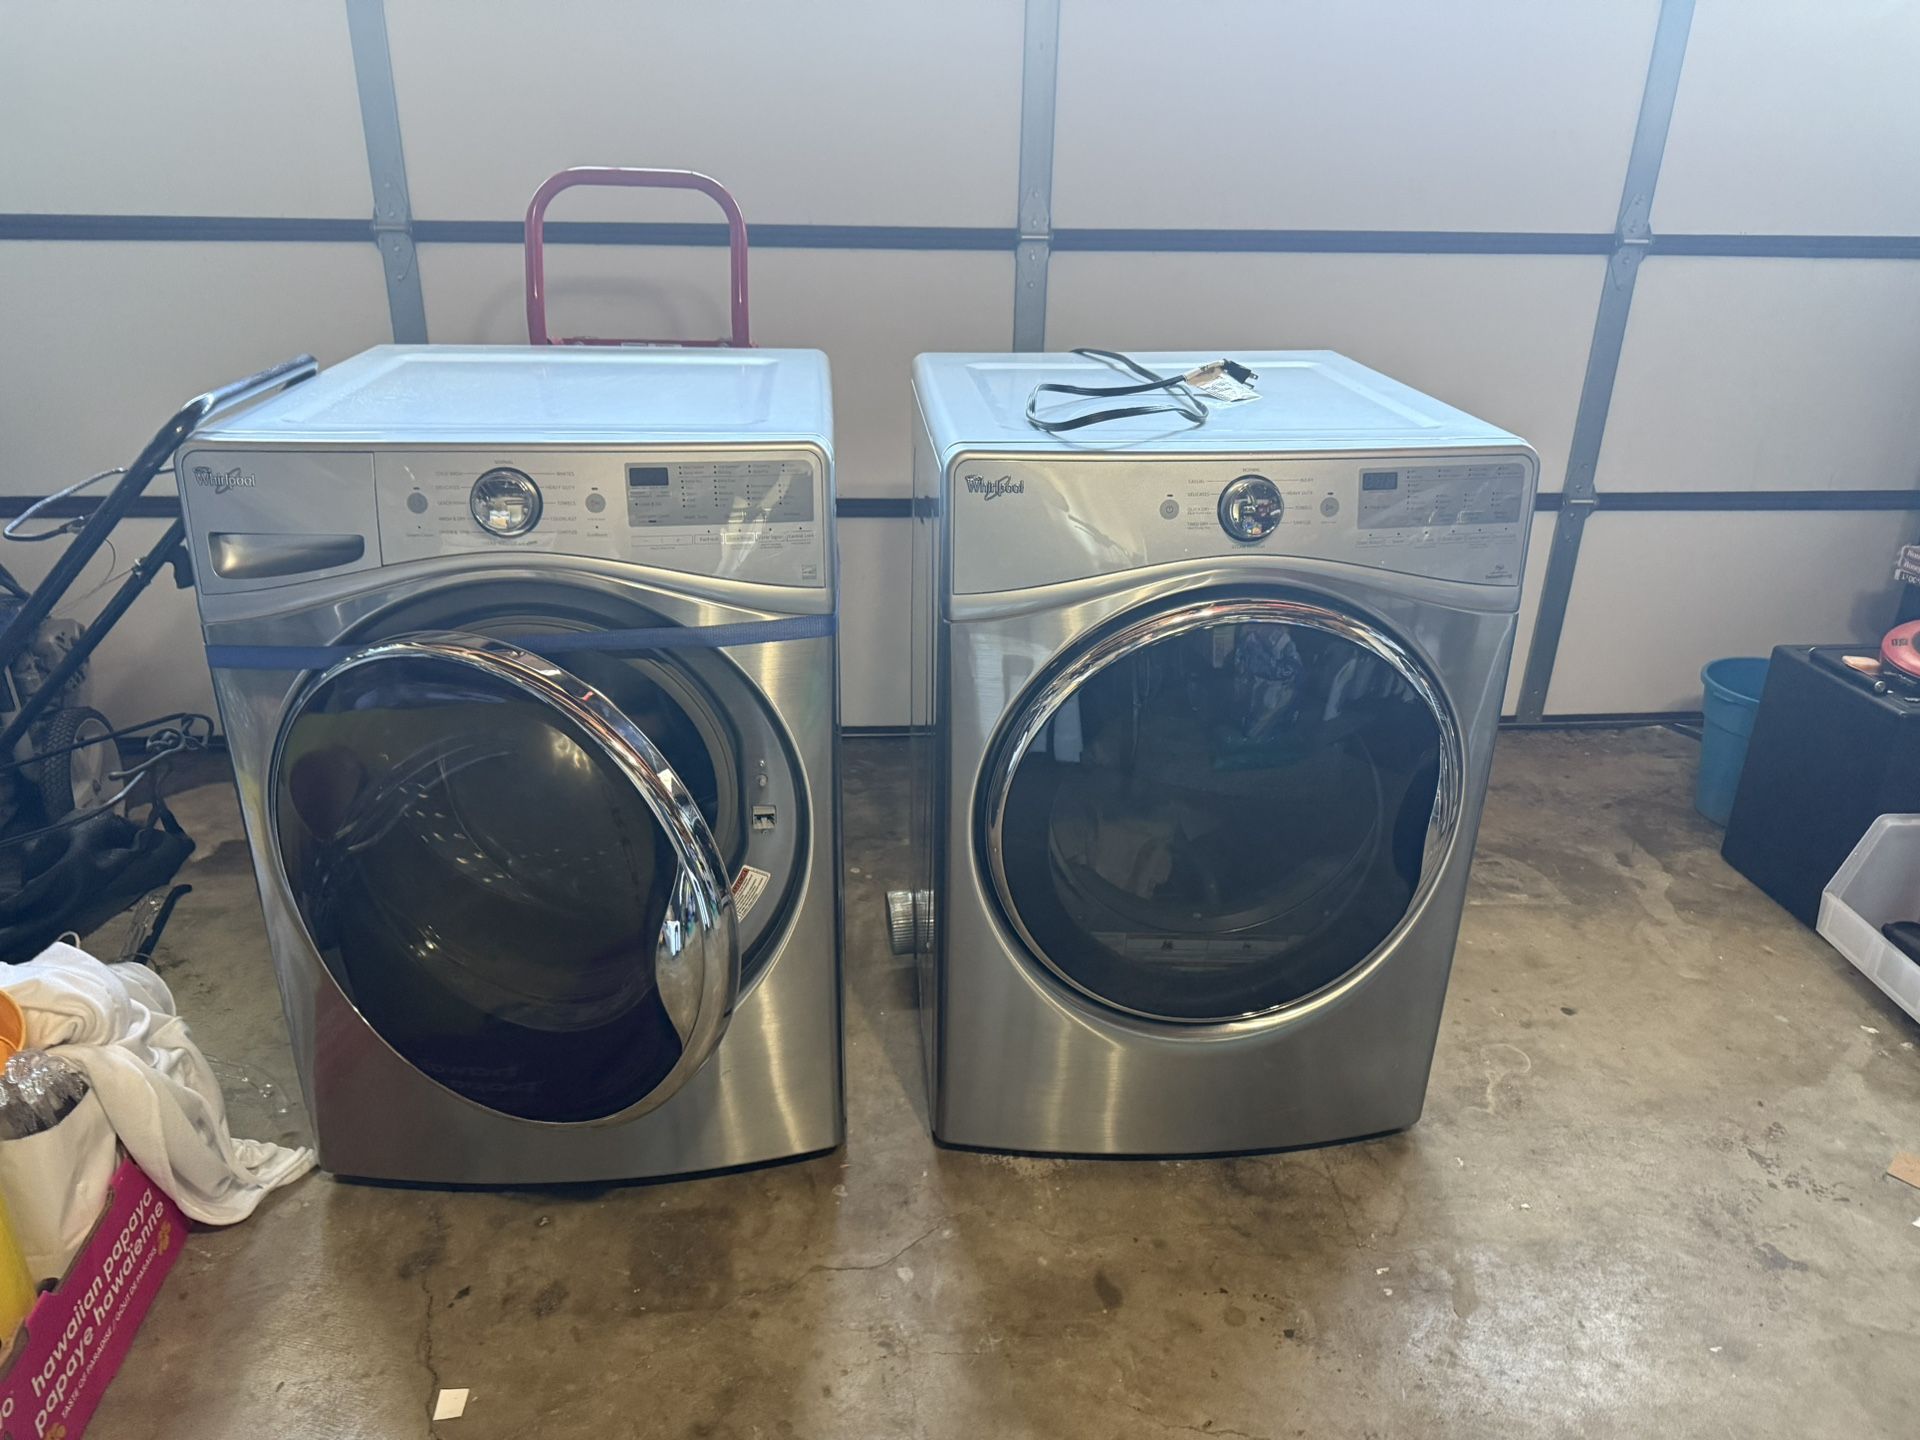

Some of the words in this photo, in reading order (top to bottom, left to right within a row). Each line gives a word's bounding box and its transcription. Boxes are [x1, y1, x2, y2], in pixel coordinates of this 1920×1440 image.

[193, 467, 257, 491] Whirlpool
[965, 474, 1025, 499] Whirlpool
[31, 1275, 103, 1397] hawaiian
[102, 1187, 153, 1283] papaya
[34, 1325, 94, 1438] papaye
[92, 1201, 164, 1326] hawaïenne
[86, 1324, 114, 1375] PARADISE
